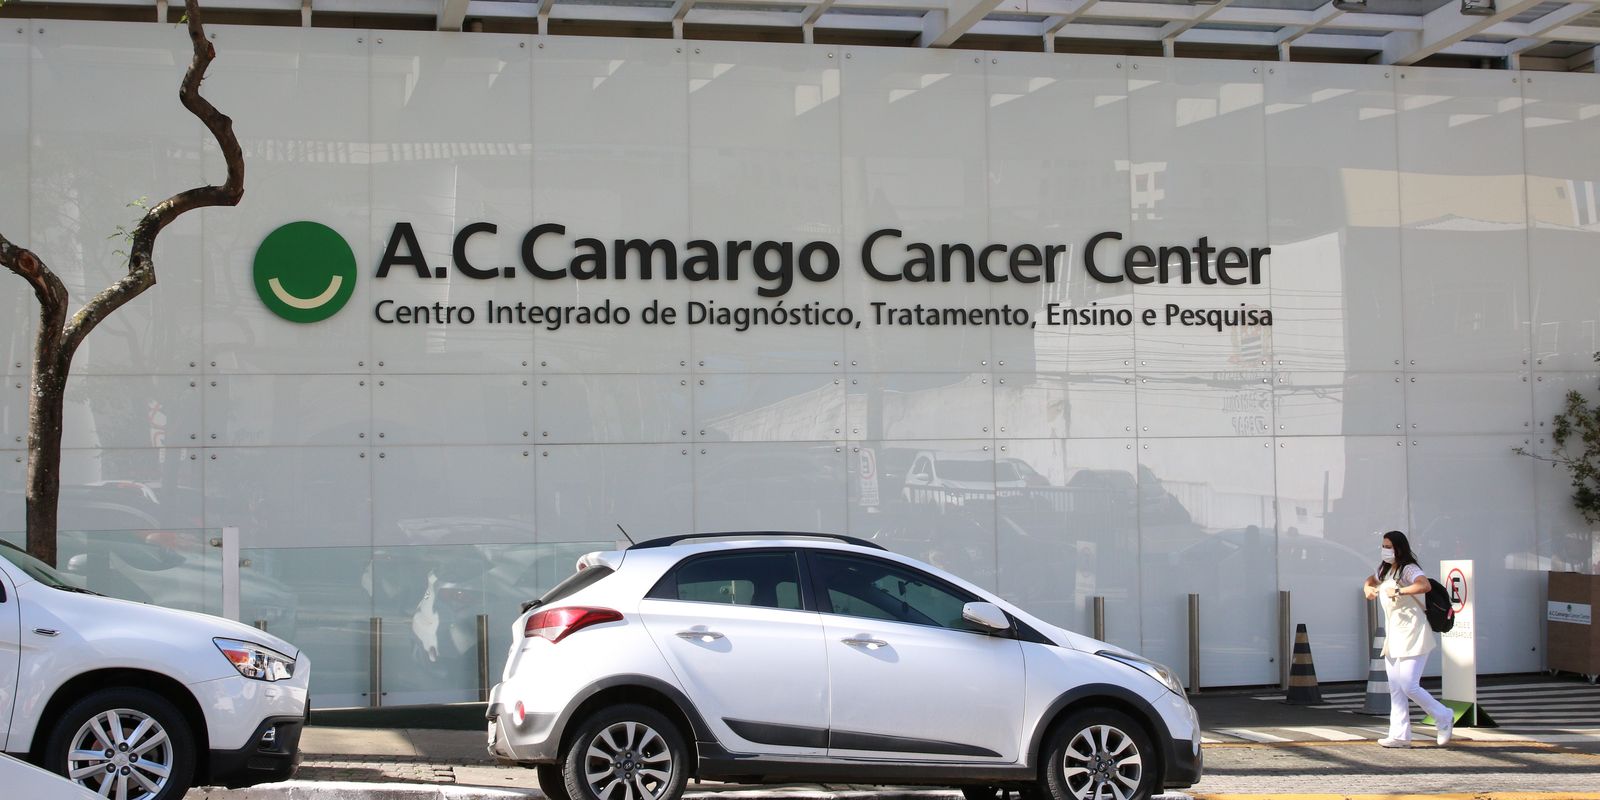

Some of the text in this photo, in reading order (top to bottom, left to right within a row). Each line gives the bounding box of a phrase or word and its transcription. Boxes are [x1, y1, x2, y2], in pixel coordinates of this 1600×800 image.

[375, 221, 1272, 298] A.C.Camargo Cancer Center
[375, 299, 1273, 332] Centro Integrado de Diagnóstico, Tratamento, Ensino e Pesquisa
[1451, 577, 1460, 603] E
